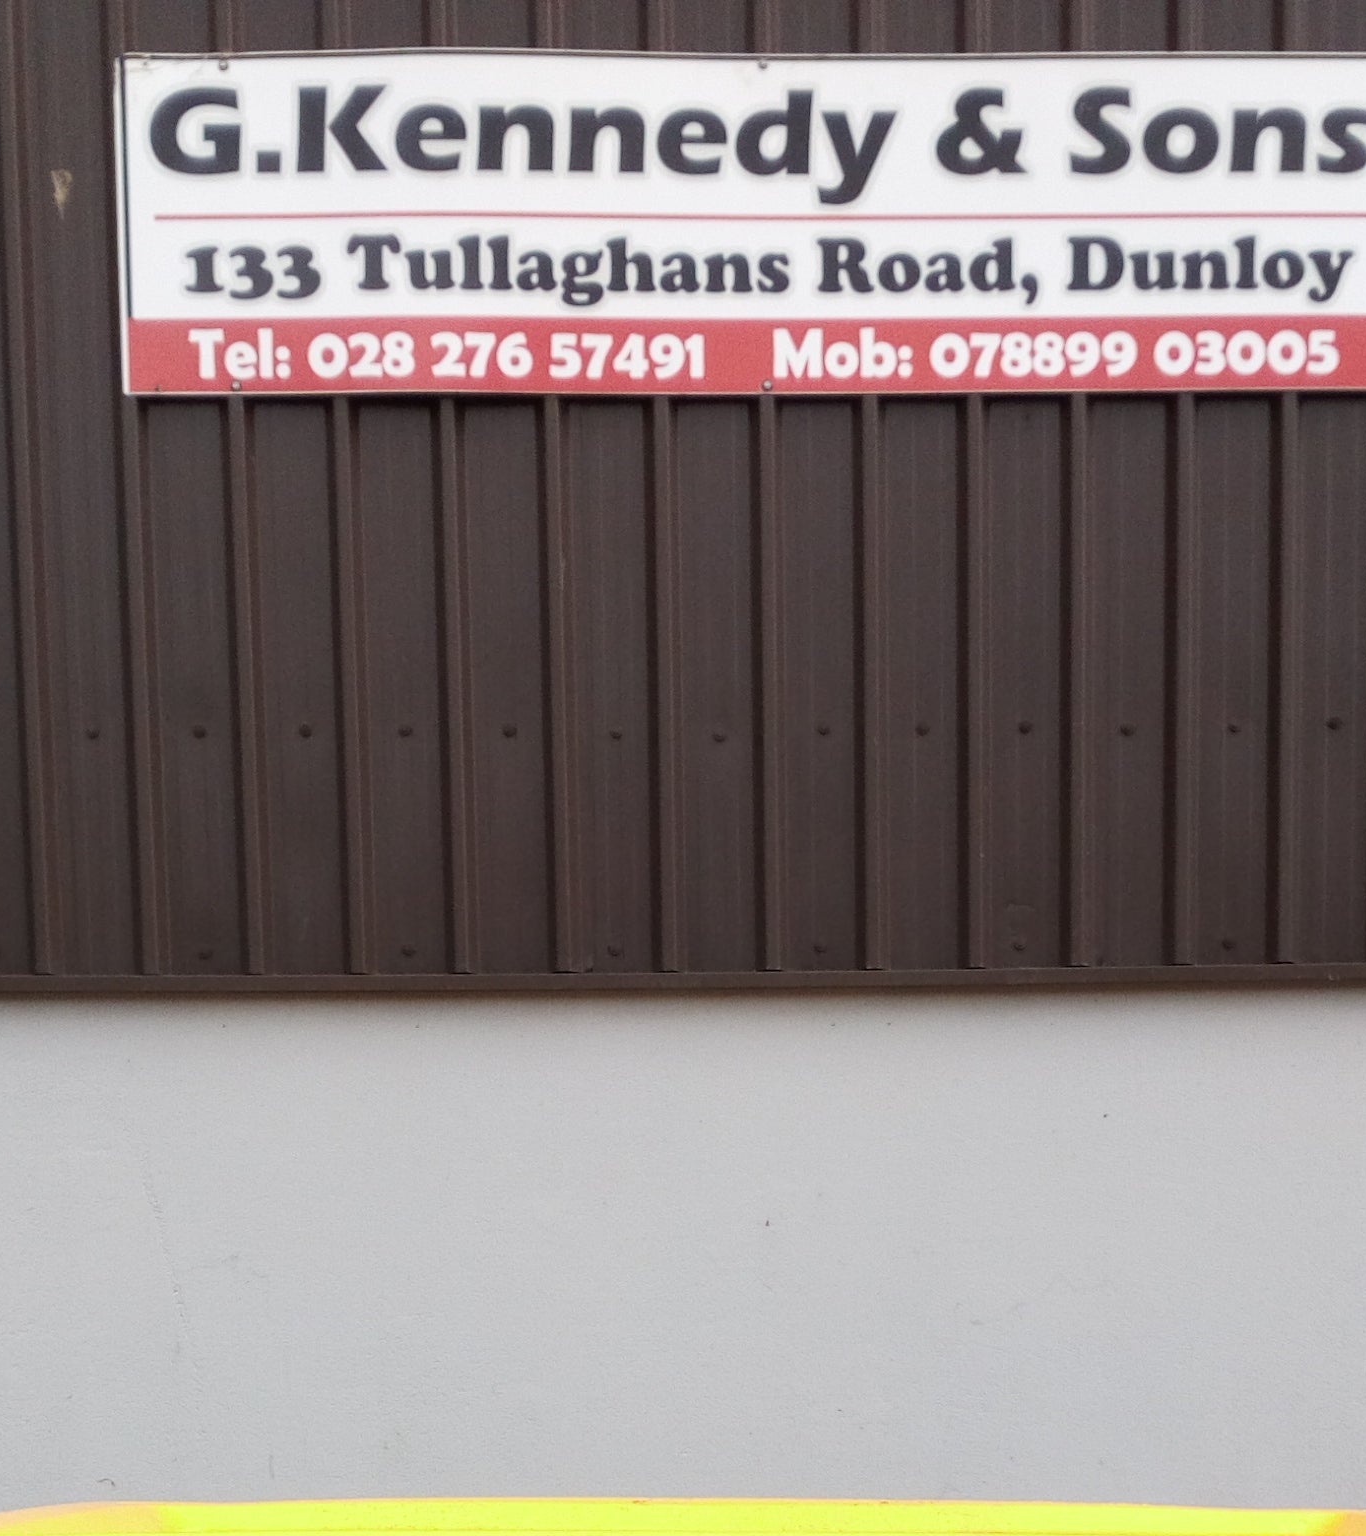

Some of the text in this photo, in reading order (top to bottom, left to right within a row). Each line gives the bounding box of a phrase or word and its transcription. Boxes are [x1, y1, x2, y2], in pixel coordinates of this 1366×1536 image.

[150, 84, 895, 204] G.Kennedy
[936, 88, 1026, 176] &
[185, 234, 1353, 306] 133 Tullaghans Road, Dunloy
[188, 326, 1341, 381] Tel: 028 276 57491 Mob: 078899 03005
